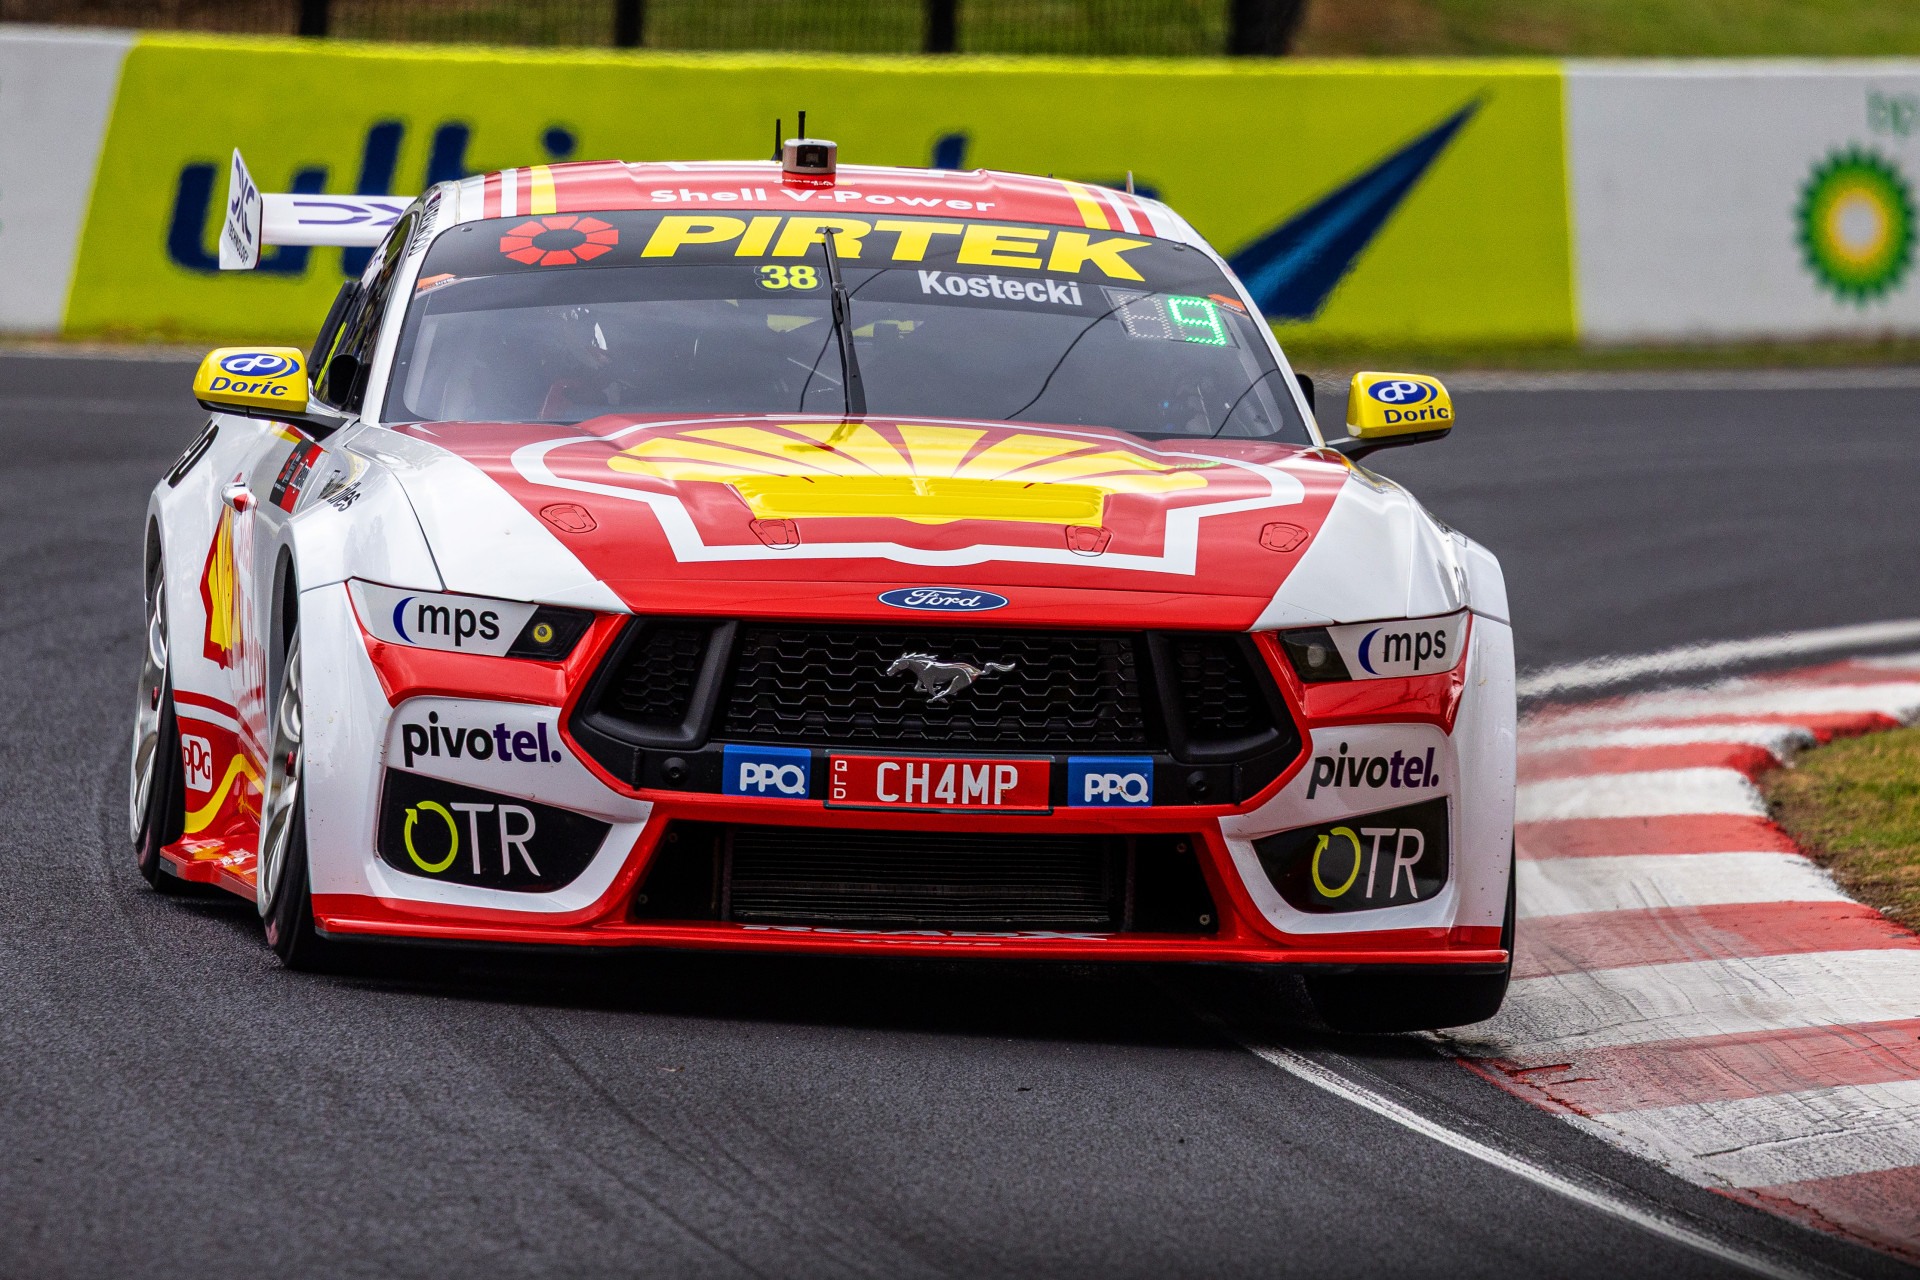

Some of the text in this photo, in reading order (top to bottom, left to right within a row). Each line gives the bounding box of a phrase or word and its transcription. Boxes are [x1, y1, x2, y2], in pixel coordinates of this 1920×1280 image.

[650, 188, 996, 212] Shell V-Power
[641, 215, 1153, 282] PIRTEK
[761, 265, 818, 289] 38
[918, 269, 1083, 306] Kostecki
[1168, 298, 1227, 346] 9
[209, 376, 288, 396] Doric
[1383, 405, 1449, 424] Doric
[903, 588, 981, 607] Ford
[417, 603, 501, 647] mps
[1382, 629, 1447, 671] mps
[402, 710, 562, 768] pivotel.
[739, 761, 806, 795] PPQ
[876, 760, 1019, 806] CH4MP
[1084, 773, 1150, 803] PPQ
[1306, 741, 1440, 800] pivotel.
[403, 800, 541, 877] OTR
[1311, 826, 1426, 900] OTR
